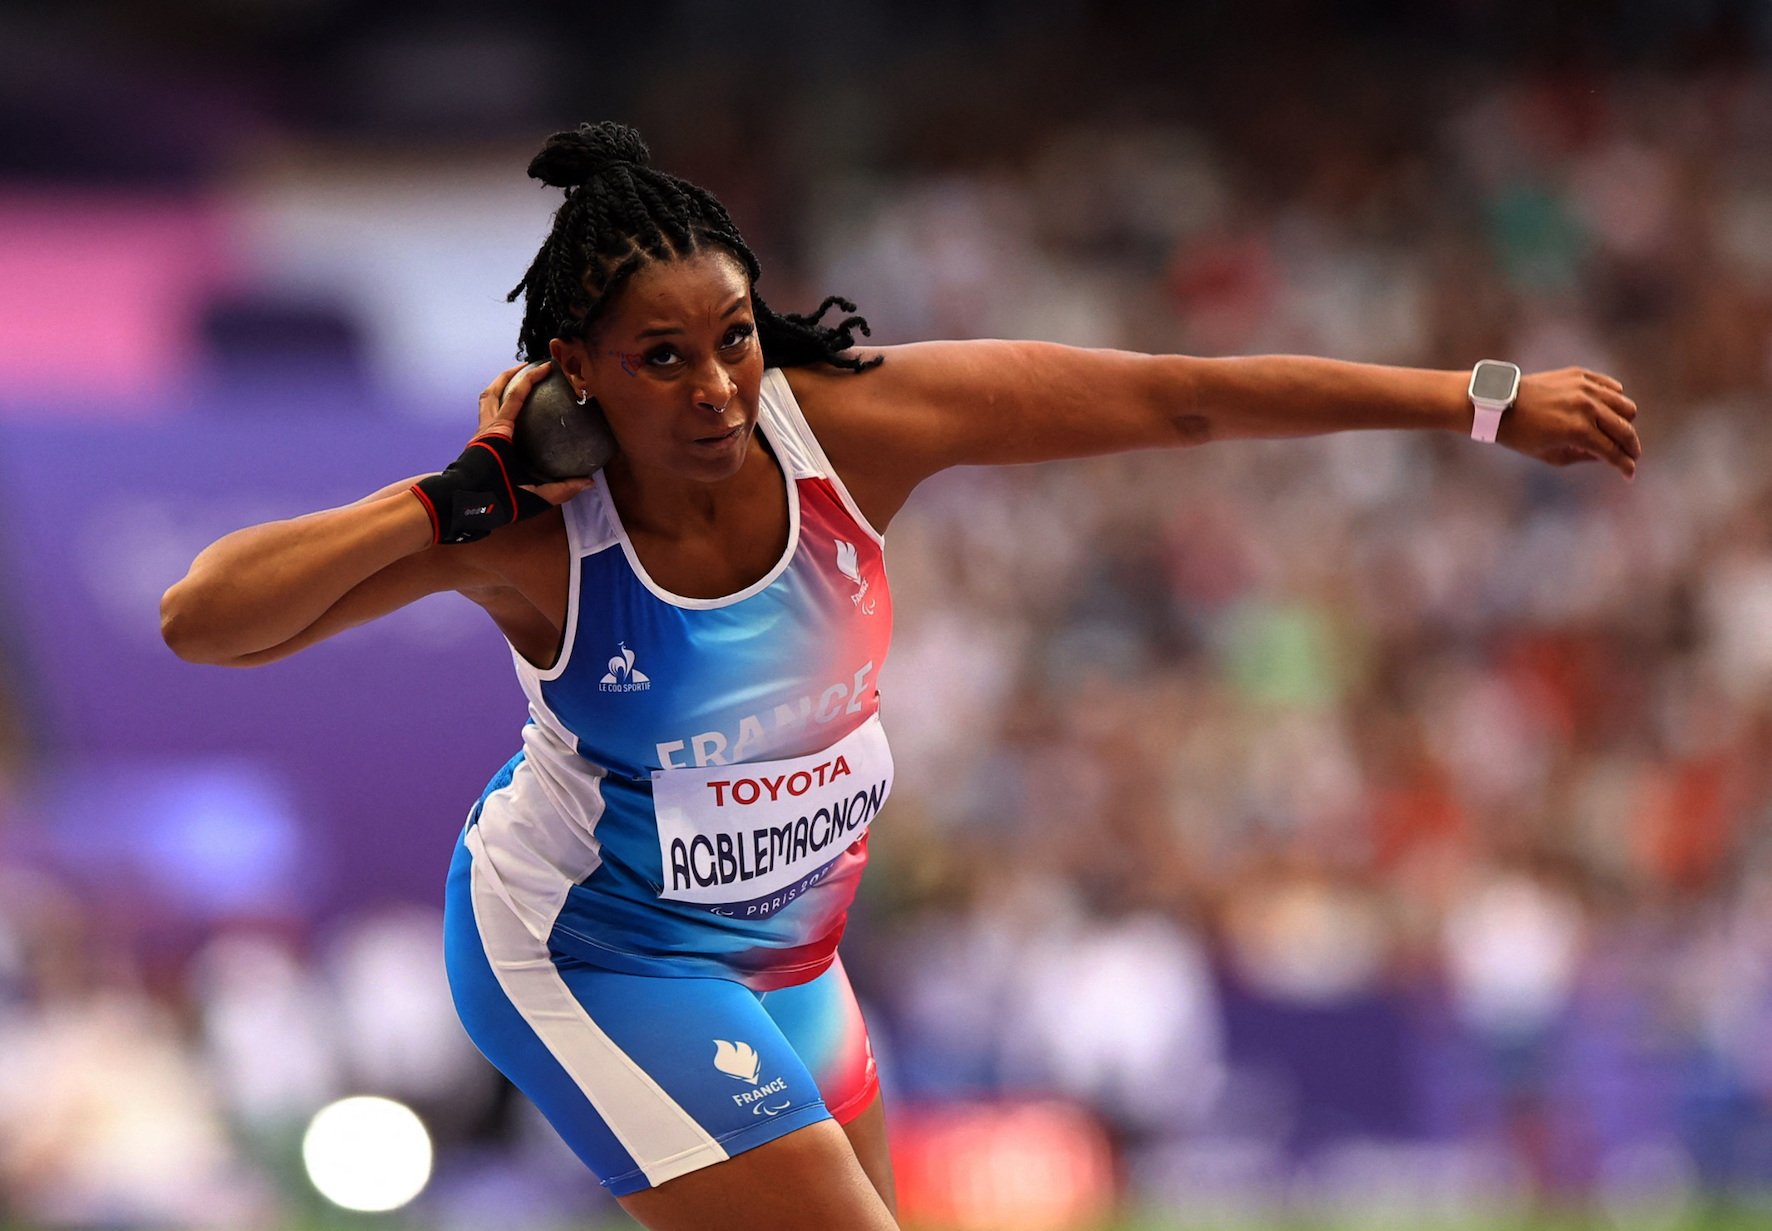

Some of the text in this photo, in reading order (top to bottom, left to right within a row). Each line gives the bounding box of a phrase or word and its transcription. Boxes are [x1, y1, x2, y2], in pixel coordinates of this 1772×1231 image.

[598, 682, 651, 693] LE COQ SPORTIF
[707, 755, 851, 807] TOYOTA
[671, 779, 886, 891] AGBLEMAGNON
[746, 888, 796, 916] PARIS
[732, 1076, 788, 1107] FRANCE
